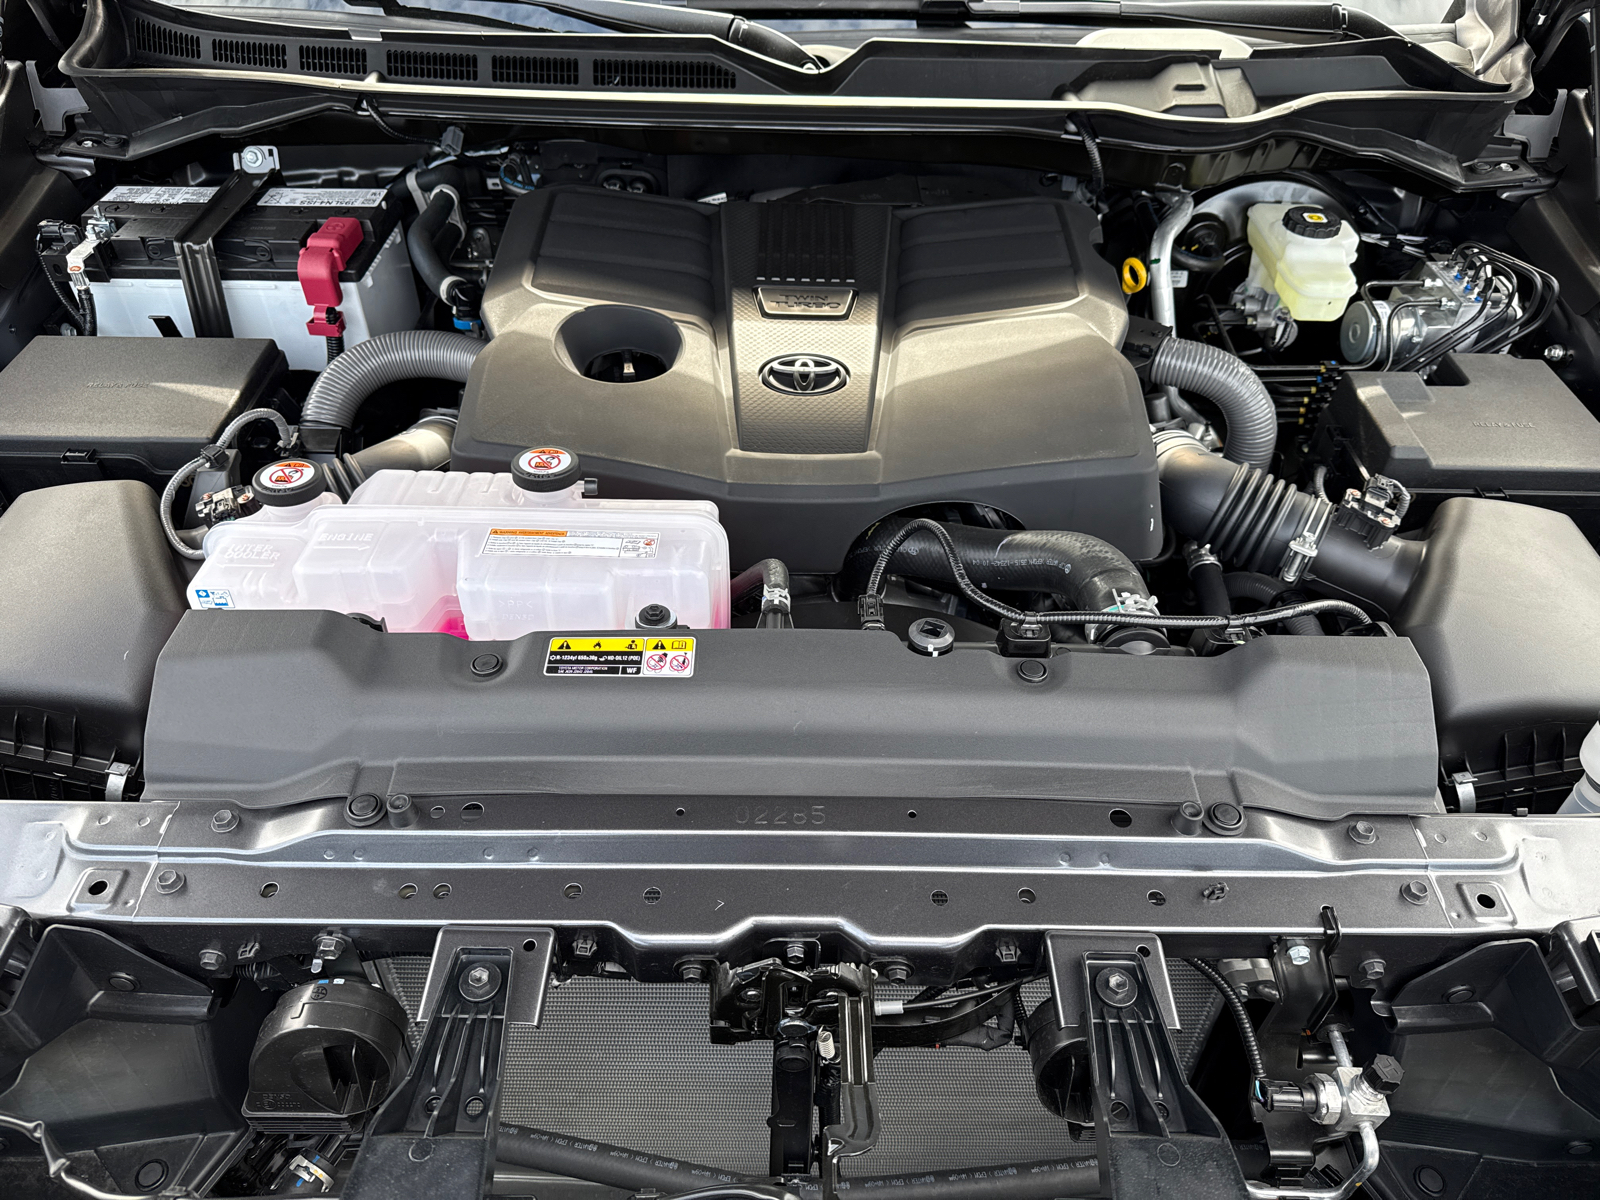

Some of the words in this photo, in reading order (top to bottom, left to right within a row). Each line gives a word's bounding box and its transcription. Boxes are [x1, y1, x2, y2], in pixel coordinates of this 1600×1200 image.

[770, 301, 841, 309] TURBO
[317, 533, 374, 541] ENGINE
[228, 544, 274, 552] INTER
[223, 551, 281, 560] COOLER
[502, 613, 535, 621] DENSO
